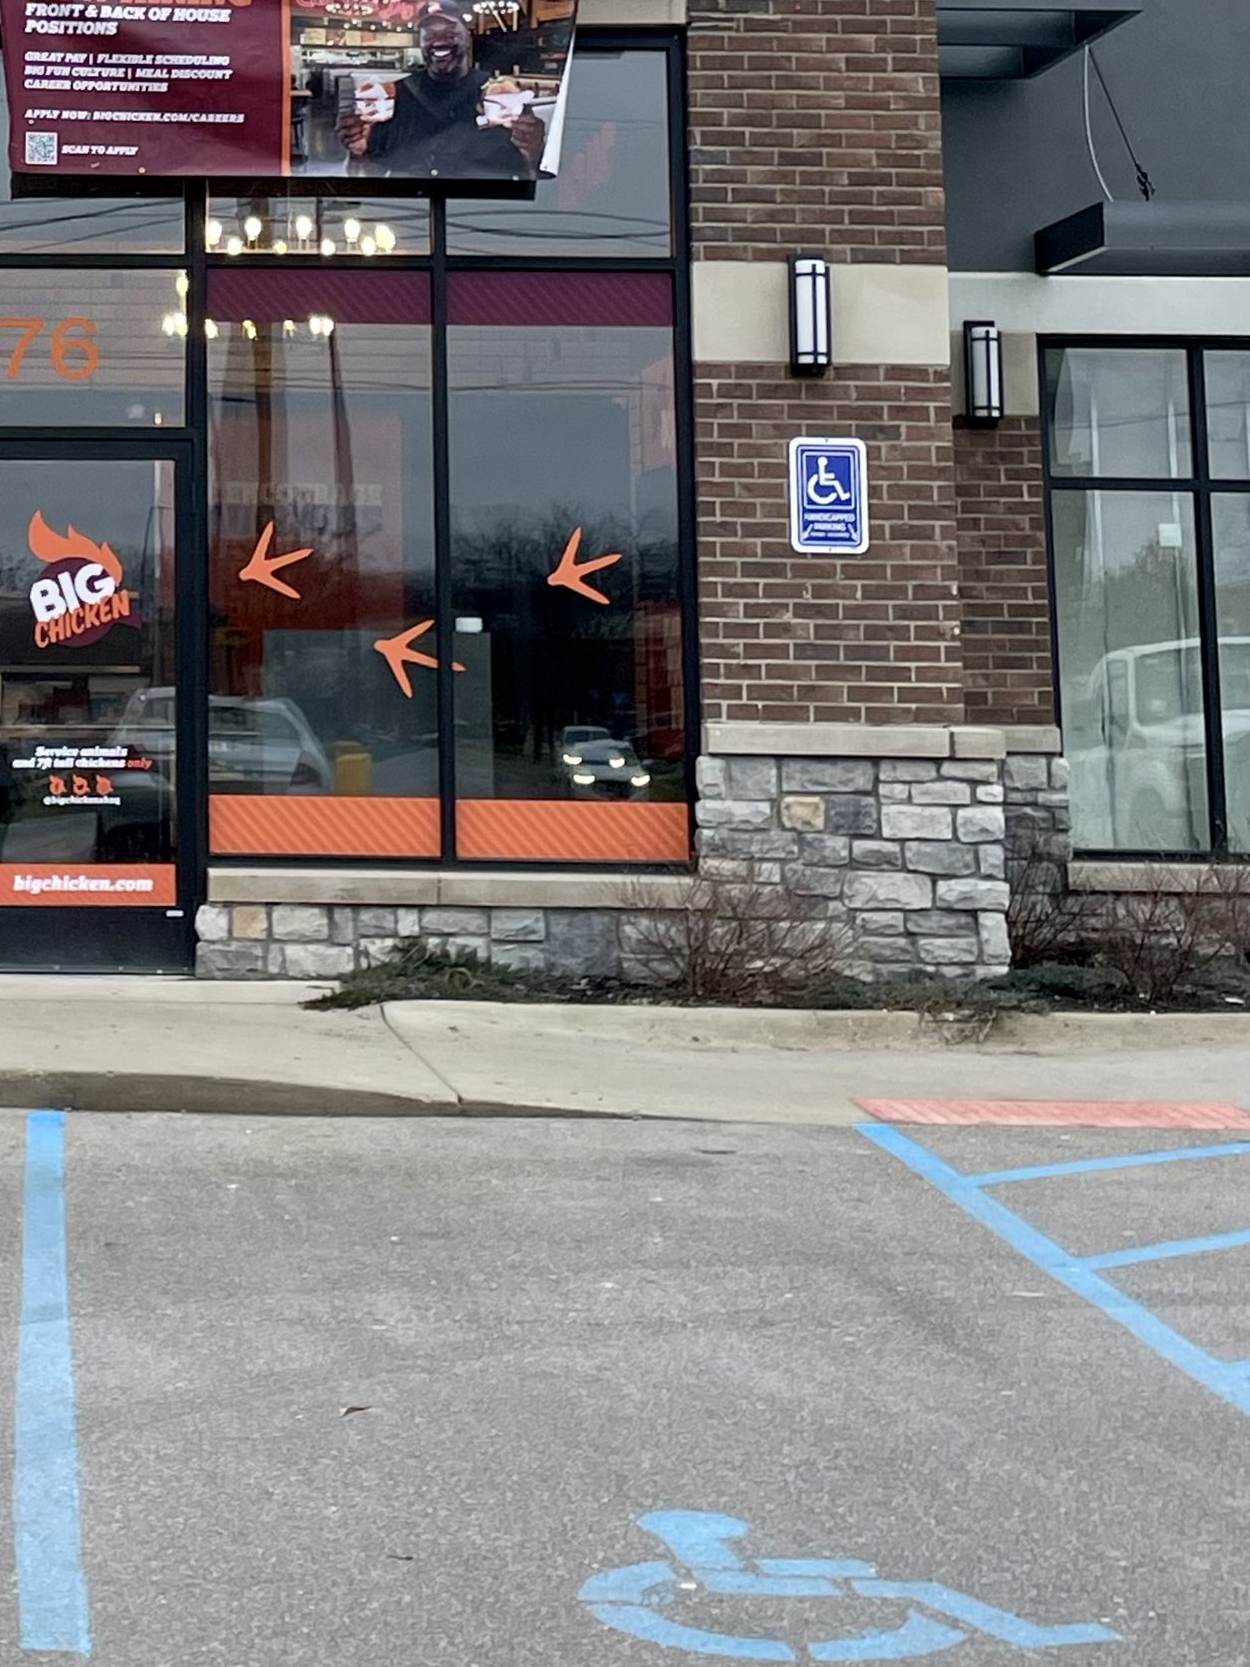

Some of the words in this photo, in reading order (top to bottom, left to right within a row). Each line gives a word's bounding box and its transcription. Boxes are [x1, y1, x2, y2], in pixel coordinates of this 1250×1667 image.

[25, 3, 84, 18] FRONT
[85, 5, 97, 19] &
[100, 6, 146, 21] BACK
[148, 7, 172, 21] OF
[173, 8, 232, 23] HOUSE
[25, 20, 117, 36] POSITIONS
[24, 51, 64, 63] GREAT
[65, 52, 88, 64] PAY
[97, 54, 153, 65] FLEXIBLE
[154, 55, 230, 66] SCHEDULING
[24, 65, 44, 76] BIG
[46, 66, 69, 77] FUN
[71, 67, 126, 78] CULTURE
[135, 68, 169, 79] MEAL
[171, 69, 233, 80] DISCOUNT
[24, 79, 71, 90] CAREER
[73, 81, 168, 92] OPPORTUNITIES
[25, 109, 60, 120] APPLY
[62, 145, 90, 155] SCAN
[91, 146, 104, 155] TO
[106, 146, 139, 156] APPLY
[30, 563, 115, 622] BIG
[35, 589, 130, 648] CHICKEN
[127, 758, 153, 770] only
[13, 874, 153, 895] bigchicken.com
